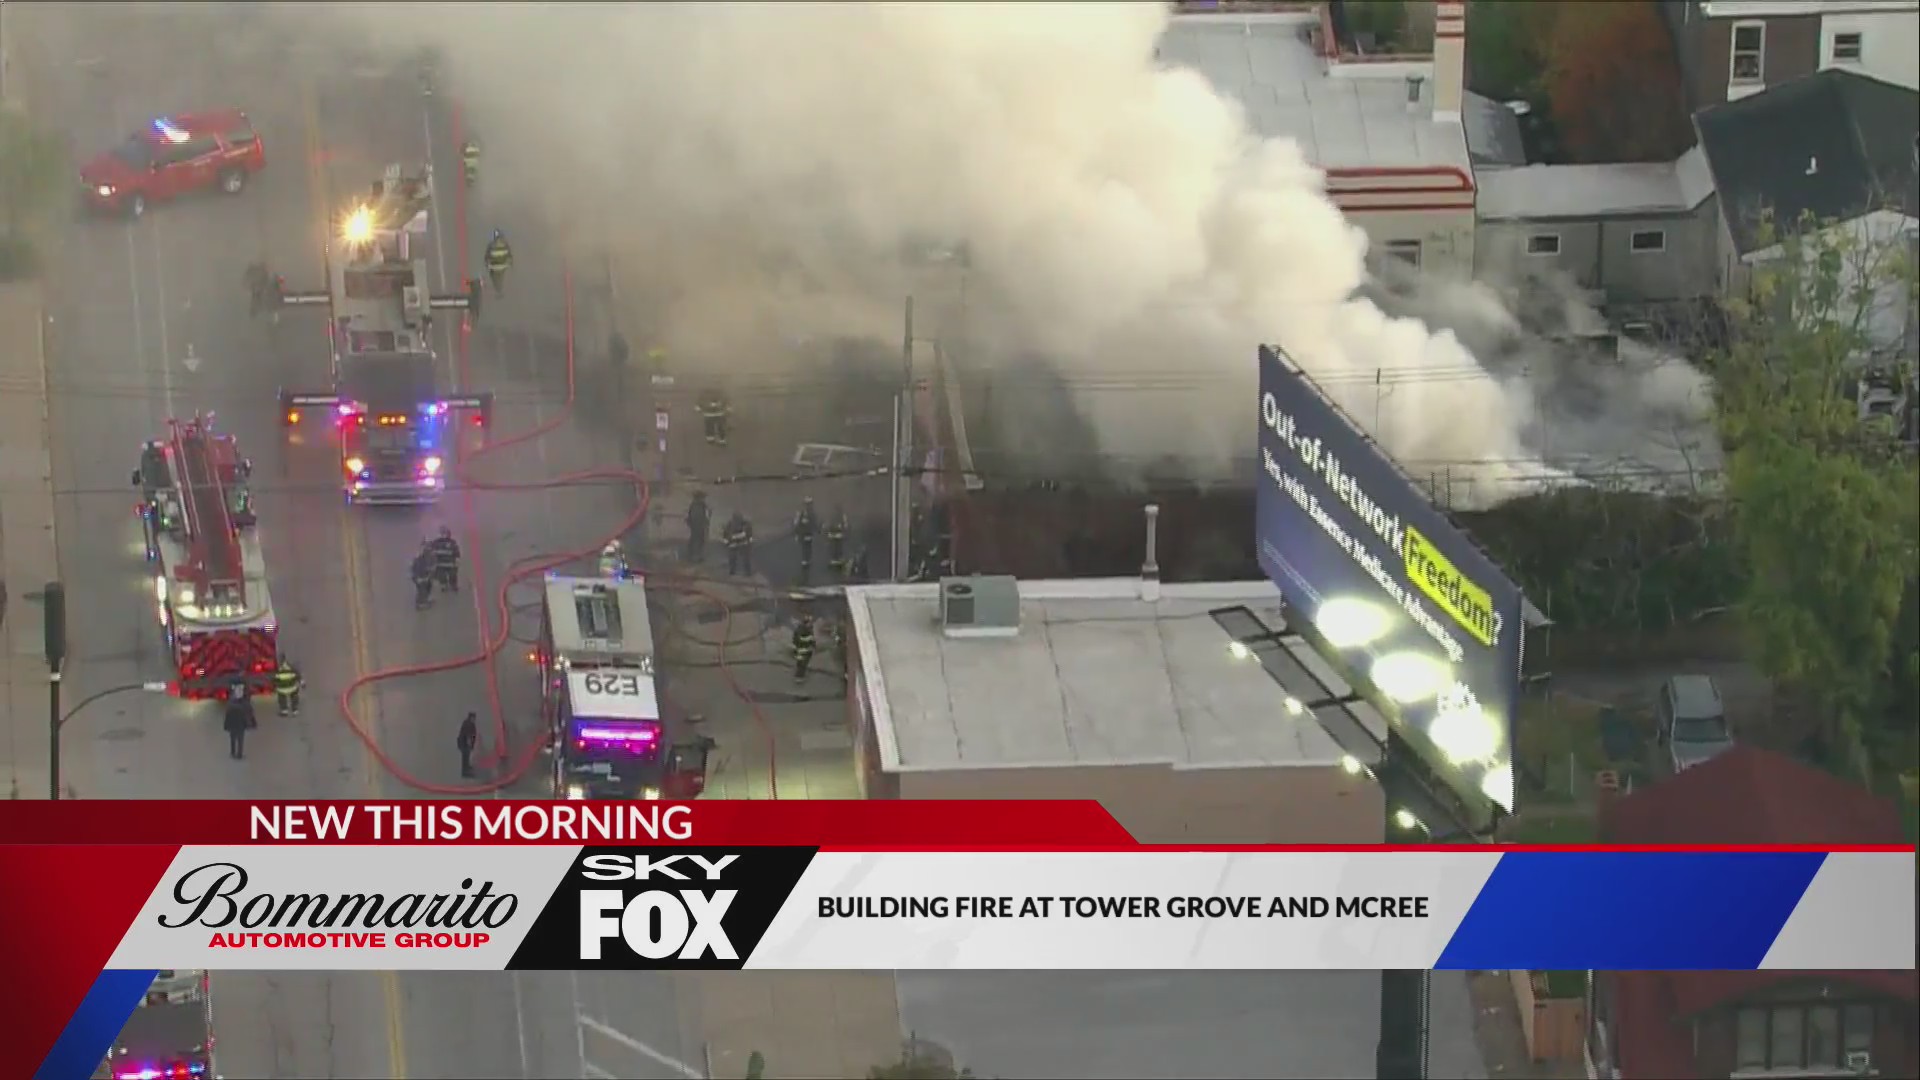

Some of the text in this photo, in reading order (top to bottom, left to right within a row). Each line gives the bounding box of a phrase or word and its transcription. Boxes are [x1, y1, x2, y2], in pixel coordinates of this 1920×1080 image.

[1263, 392, 1404, 557] Out-of-Network
[1408, 533, 1503, 646] Freedom?
[1283, 472, 1309, 511] with
[1353, 539, 1404, 604] Medicare
[585, 673, 639, 696] E29
